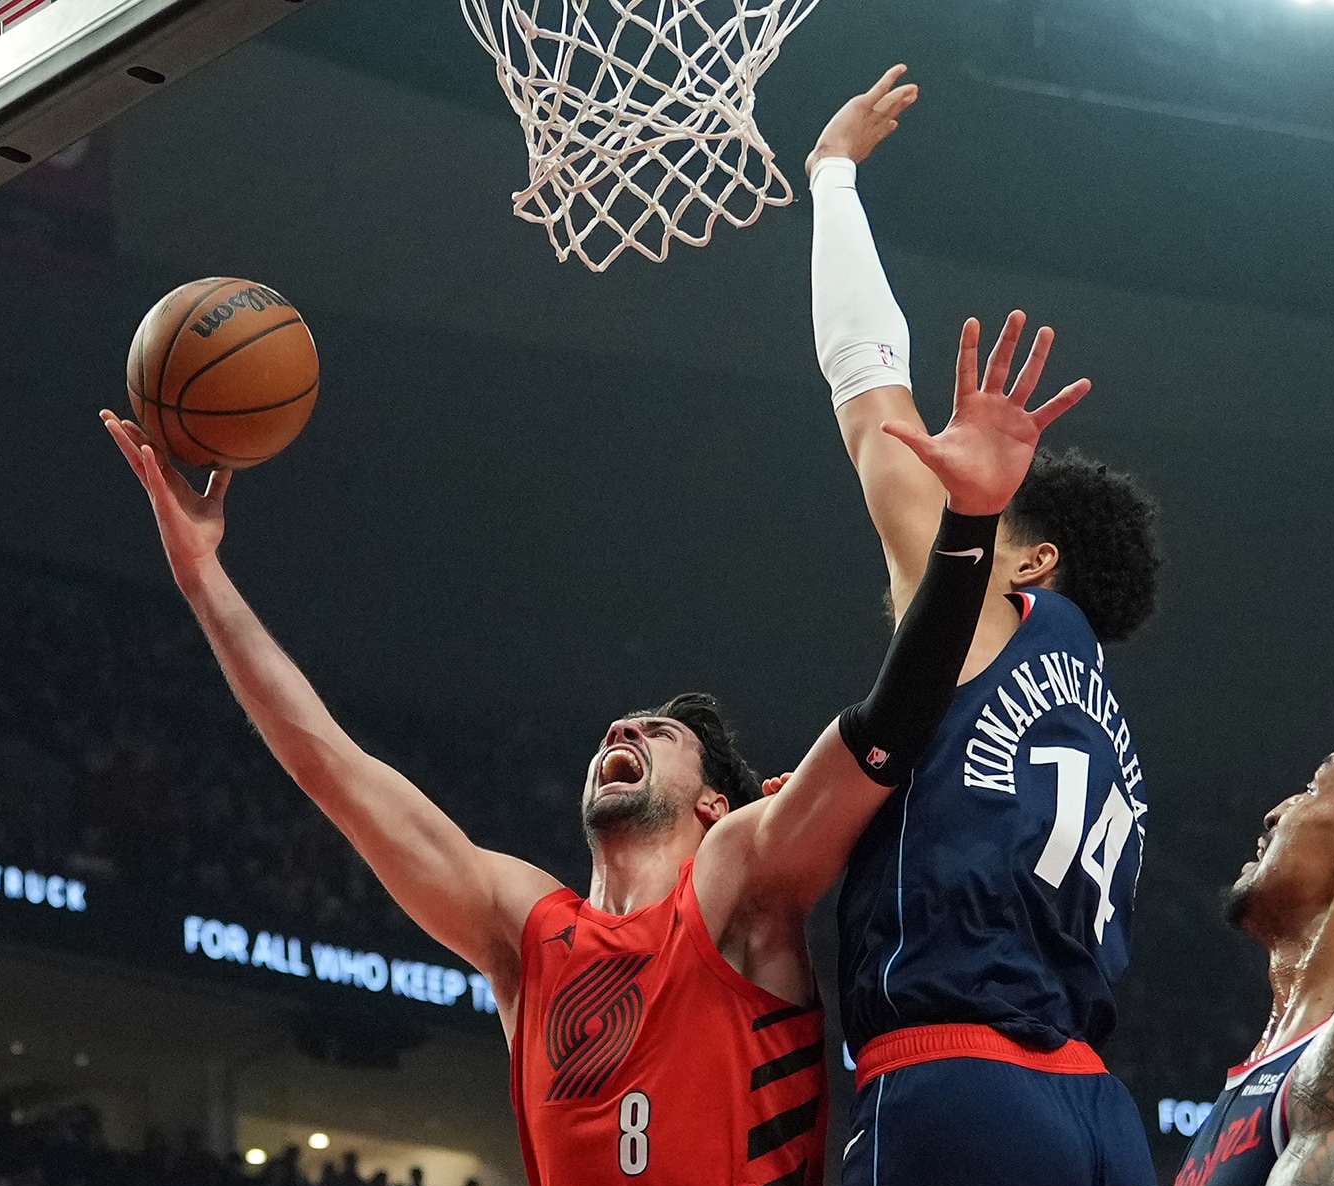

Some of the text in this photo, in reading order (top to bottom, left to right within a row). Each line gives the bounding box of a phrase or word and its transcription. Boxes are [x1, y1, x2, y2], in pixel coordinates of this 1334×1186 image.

[1029, 746, 1133, 945] 14
[183, 915, 249, 964] FOR
[251, 930, 311, 978] ALL
[311, 941, 389, 992] WHO
[390, 957, 467, 1006] KEEP
[618, 1090, 651, 1177] 8
